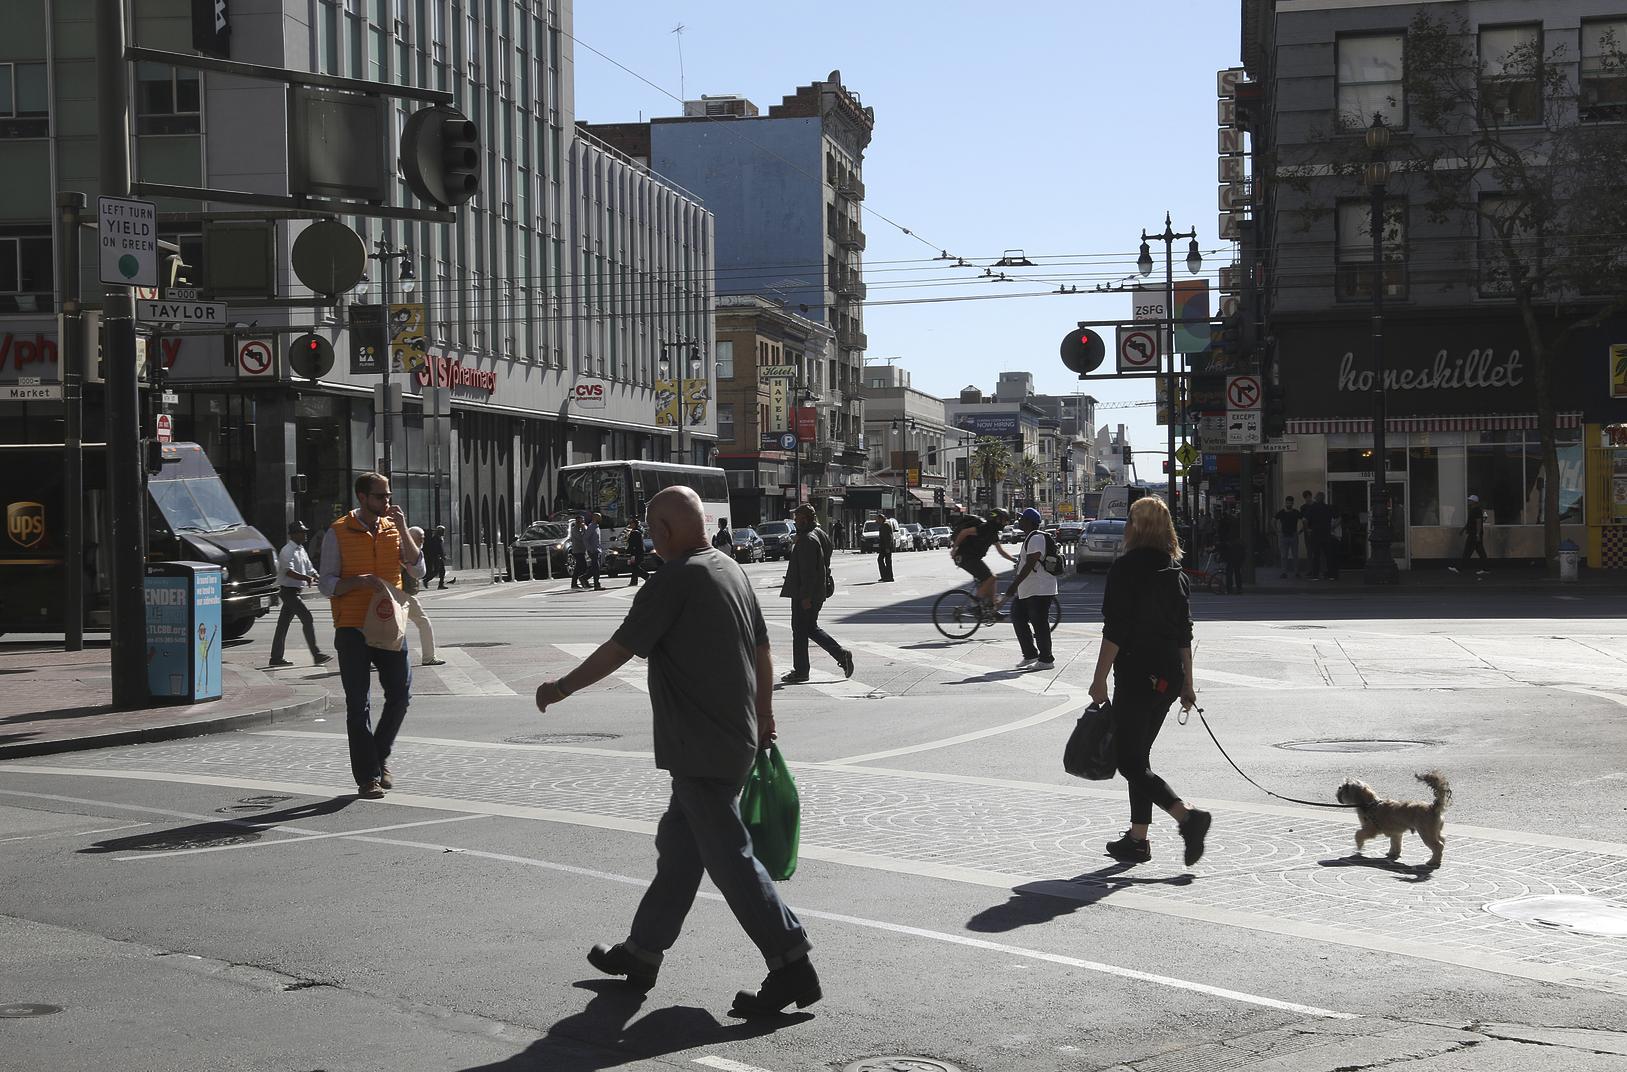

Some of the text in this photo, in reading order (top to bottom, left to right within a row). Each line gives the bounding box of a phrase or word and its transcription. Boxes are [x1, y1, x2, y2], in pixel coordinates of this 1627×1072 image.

[102, 204, 153, 219] LEFT TURN
[106, 219, 150, 236] YIELD
[103, 236, 154, 252] ON GREEN
[149, 304, 215, 320] TAYLOR
[1135, 304, 1164, 316] ZSFG
[762, 367, 795, 376] Hotel
[1338, 348, 1524, 392] homeskillet
[10, 389, 50, 398] Market
[576, 384, 603, 396] CVS
[774, 380, 782, 430] HAVELI
[1232, 413, 1256, 421] EXCEPT
[10, 515, 42, 541] ups
[144, 588, 186, 606] ENDER
